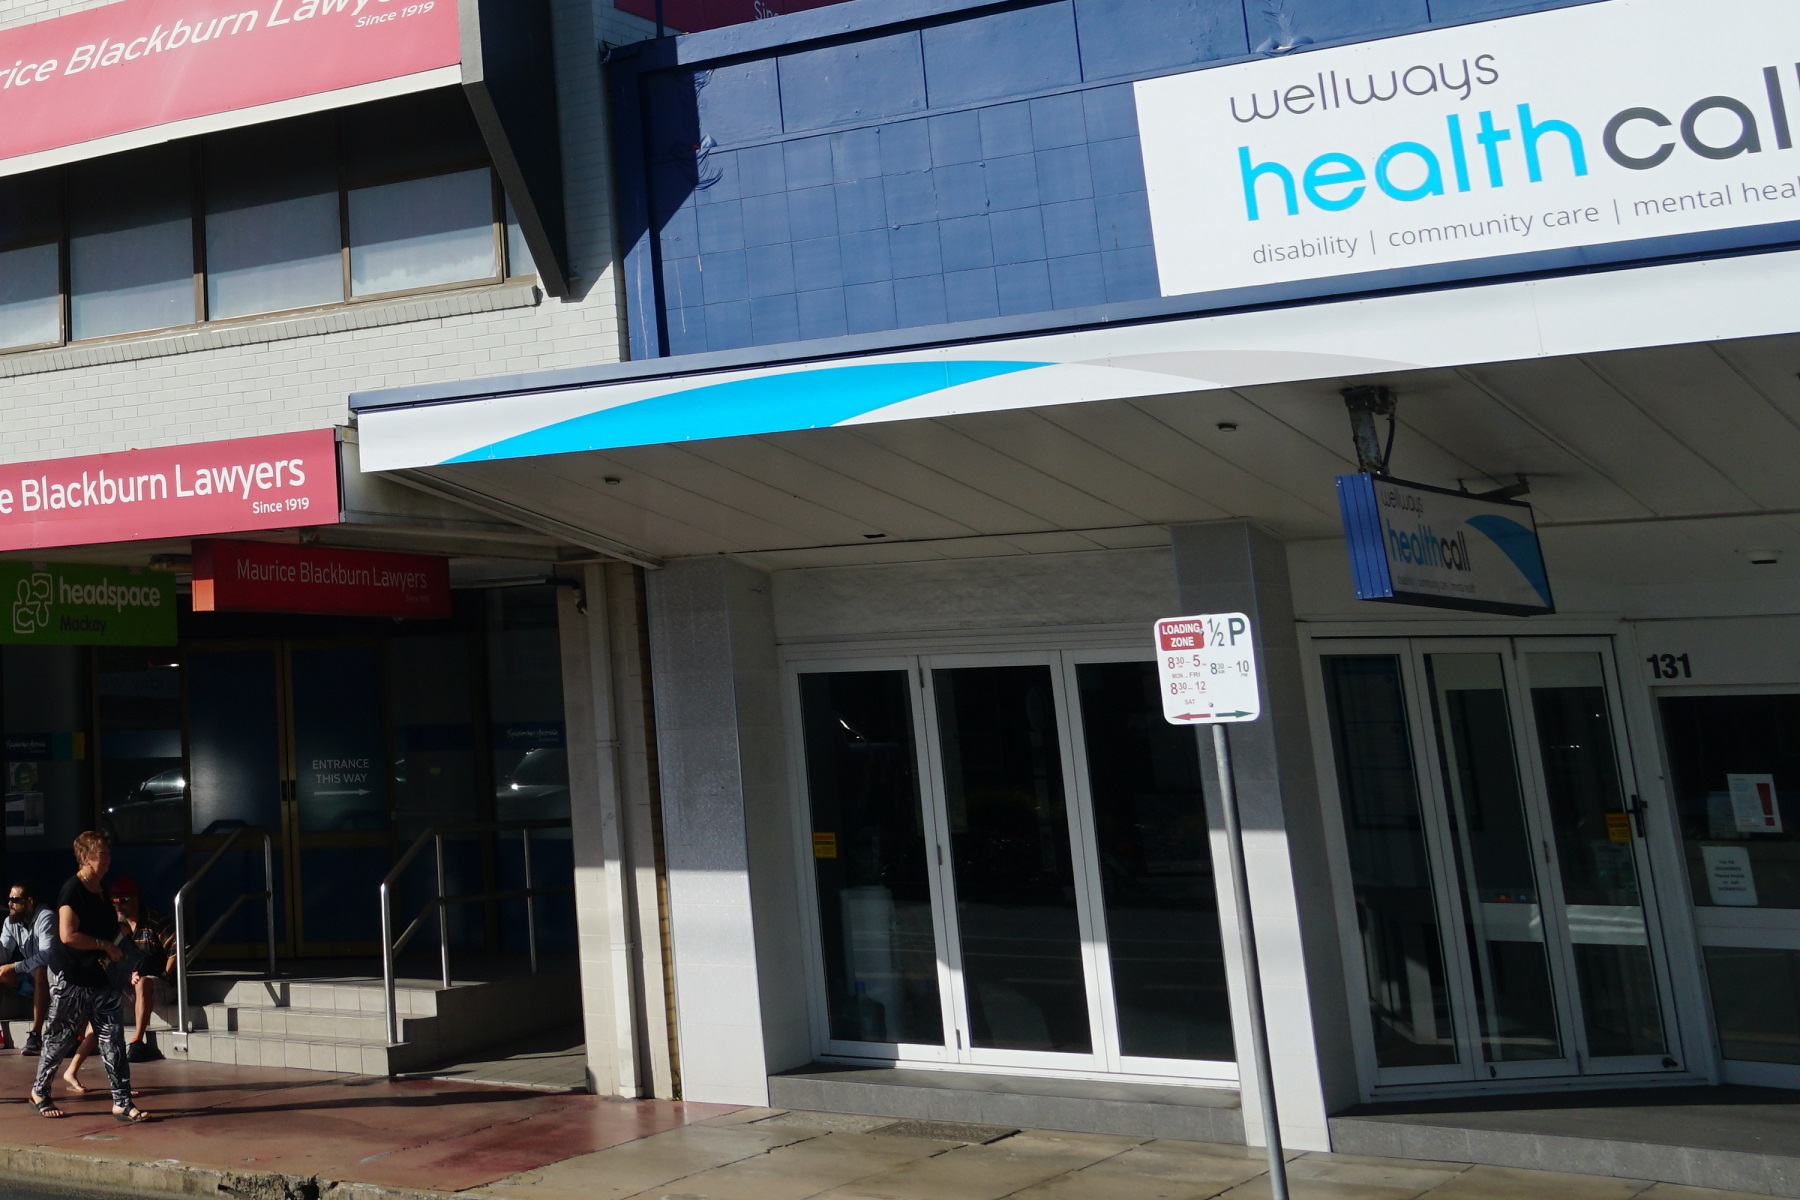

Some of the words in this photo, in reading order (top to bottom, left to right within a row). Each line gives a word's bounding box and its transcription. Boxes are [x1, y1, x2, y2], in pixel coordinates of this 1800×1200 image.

[355, 10, 397, 29] Since
[401, 1, 435, 18] 1919
[62, 9, 259, 76] Blackburn
[1229, 54, 1499, 123] wellways
[1253, 236, 1358, 264] disability
[1389, 213, 1533, 247] community
[1542, 207, 1600, 228] care
[1633, 185, 1732, 217] mental
[1741, 176, 1800, 204] hea
[20, 469, 168, 513] Blackburn
[175, 458, 306, 500] Lawyers
[252, 500, 283, 514] Since
[284, 497, 310, 512] 1919
[1380, 488, 1424, 518] wellways
[1386, 517, 1472, 572] healthcall
[236, 558, 296, 583] Maurice
[299, 562, 371, 586] Blackburn
[372, 565, 428, 592] Lawyers
[59, 575, 161, 613] headspace
[60, 614, 107, 636] Mackay
[1161, 623, 1200, 635] LOADING
[1170, 636, 1195, 648] ZONE
[1646, 653, 1692, 679] 131
[312, 758, 371, 770] ENTRANCE
[315, 773, 341, 784] THIS
[342, 772, 368, 783] WAY
